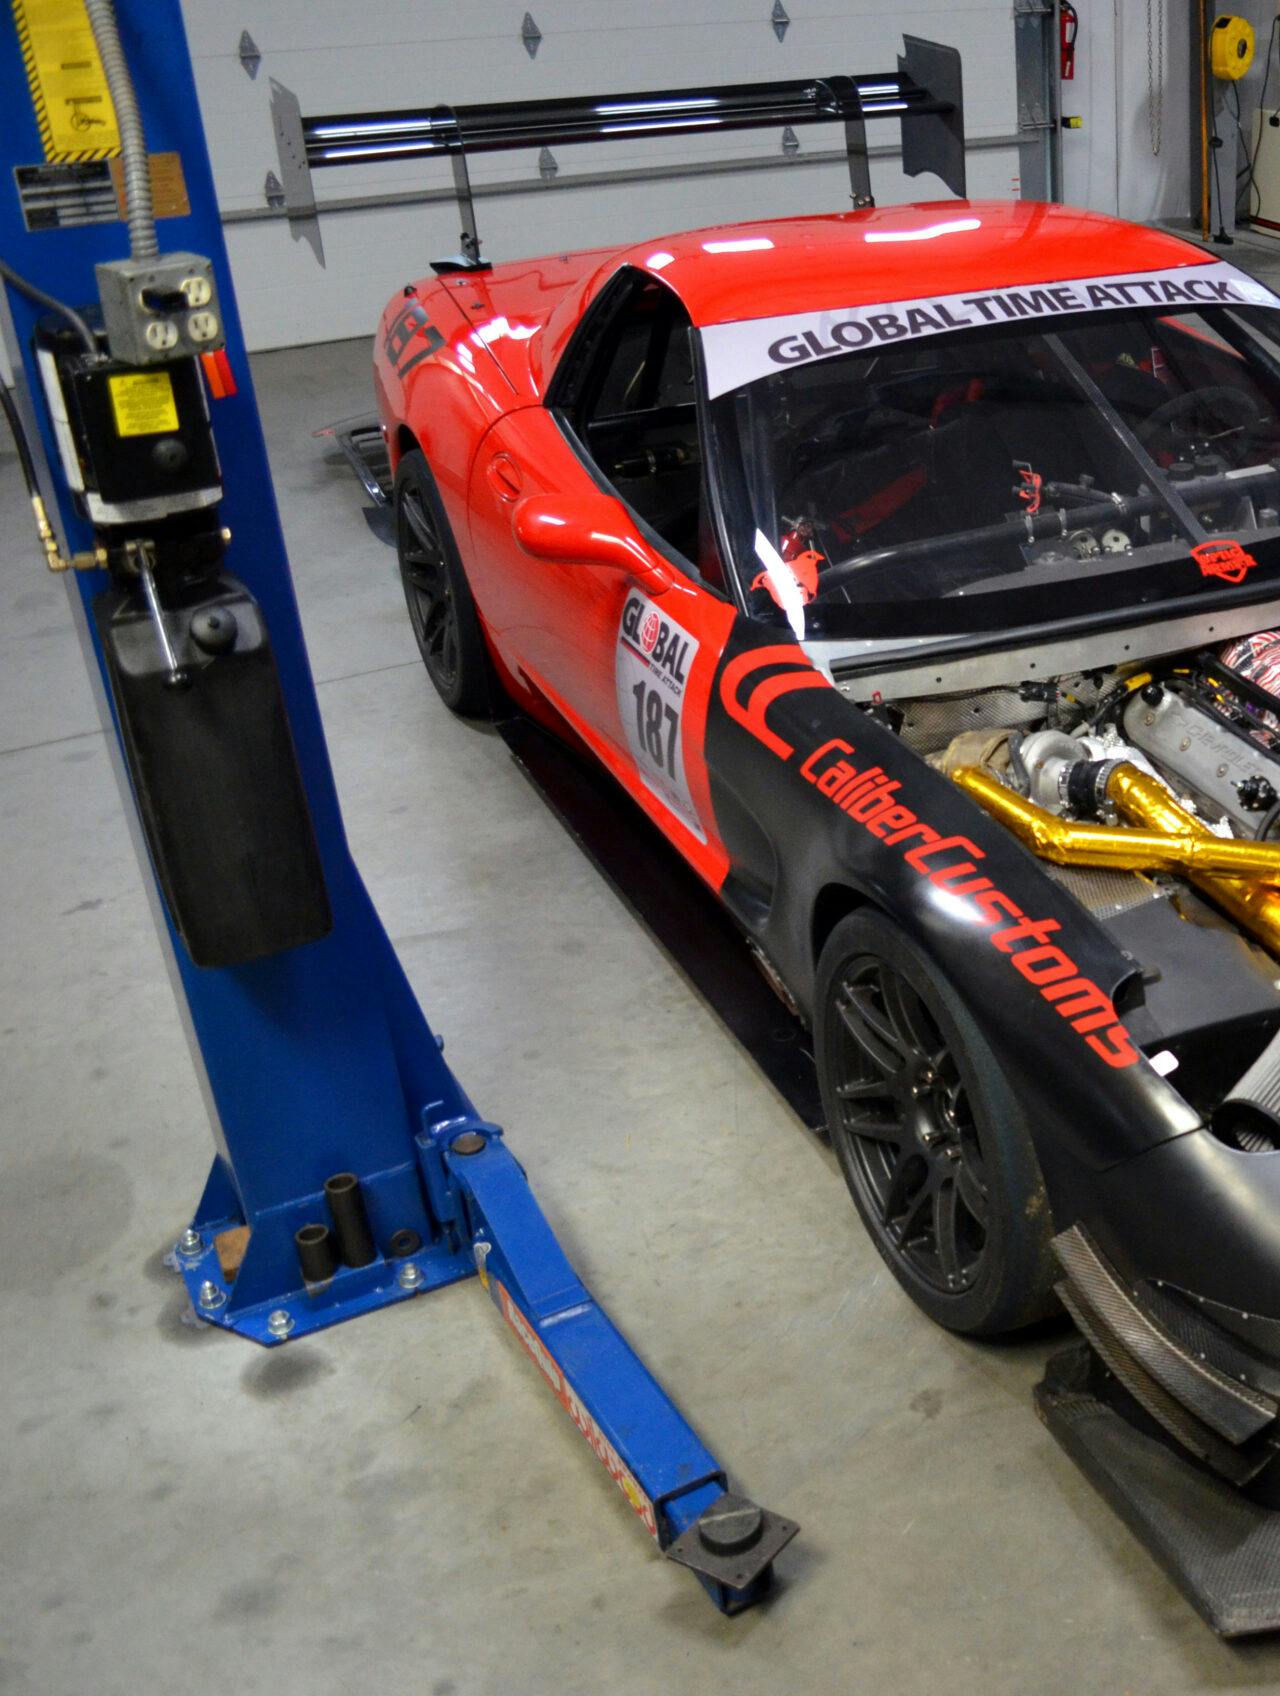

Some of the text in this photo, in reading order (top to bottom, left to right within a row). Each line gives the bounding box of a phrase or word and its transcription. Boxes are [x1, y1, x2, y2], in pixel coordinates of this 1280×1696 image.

[767, 279, 1243, 365] GLOBAL TIME ATTACK
[622, 597, 689, 684] GLOBAL
[632, 679, 680, 781] 187
